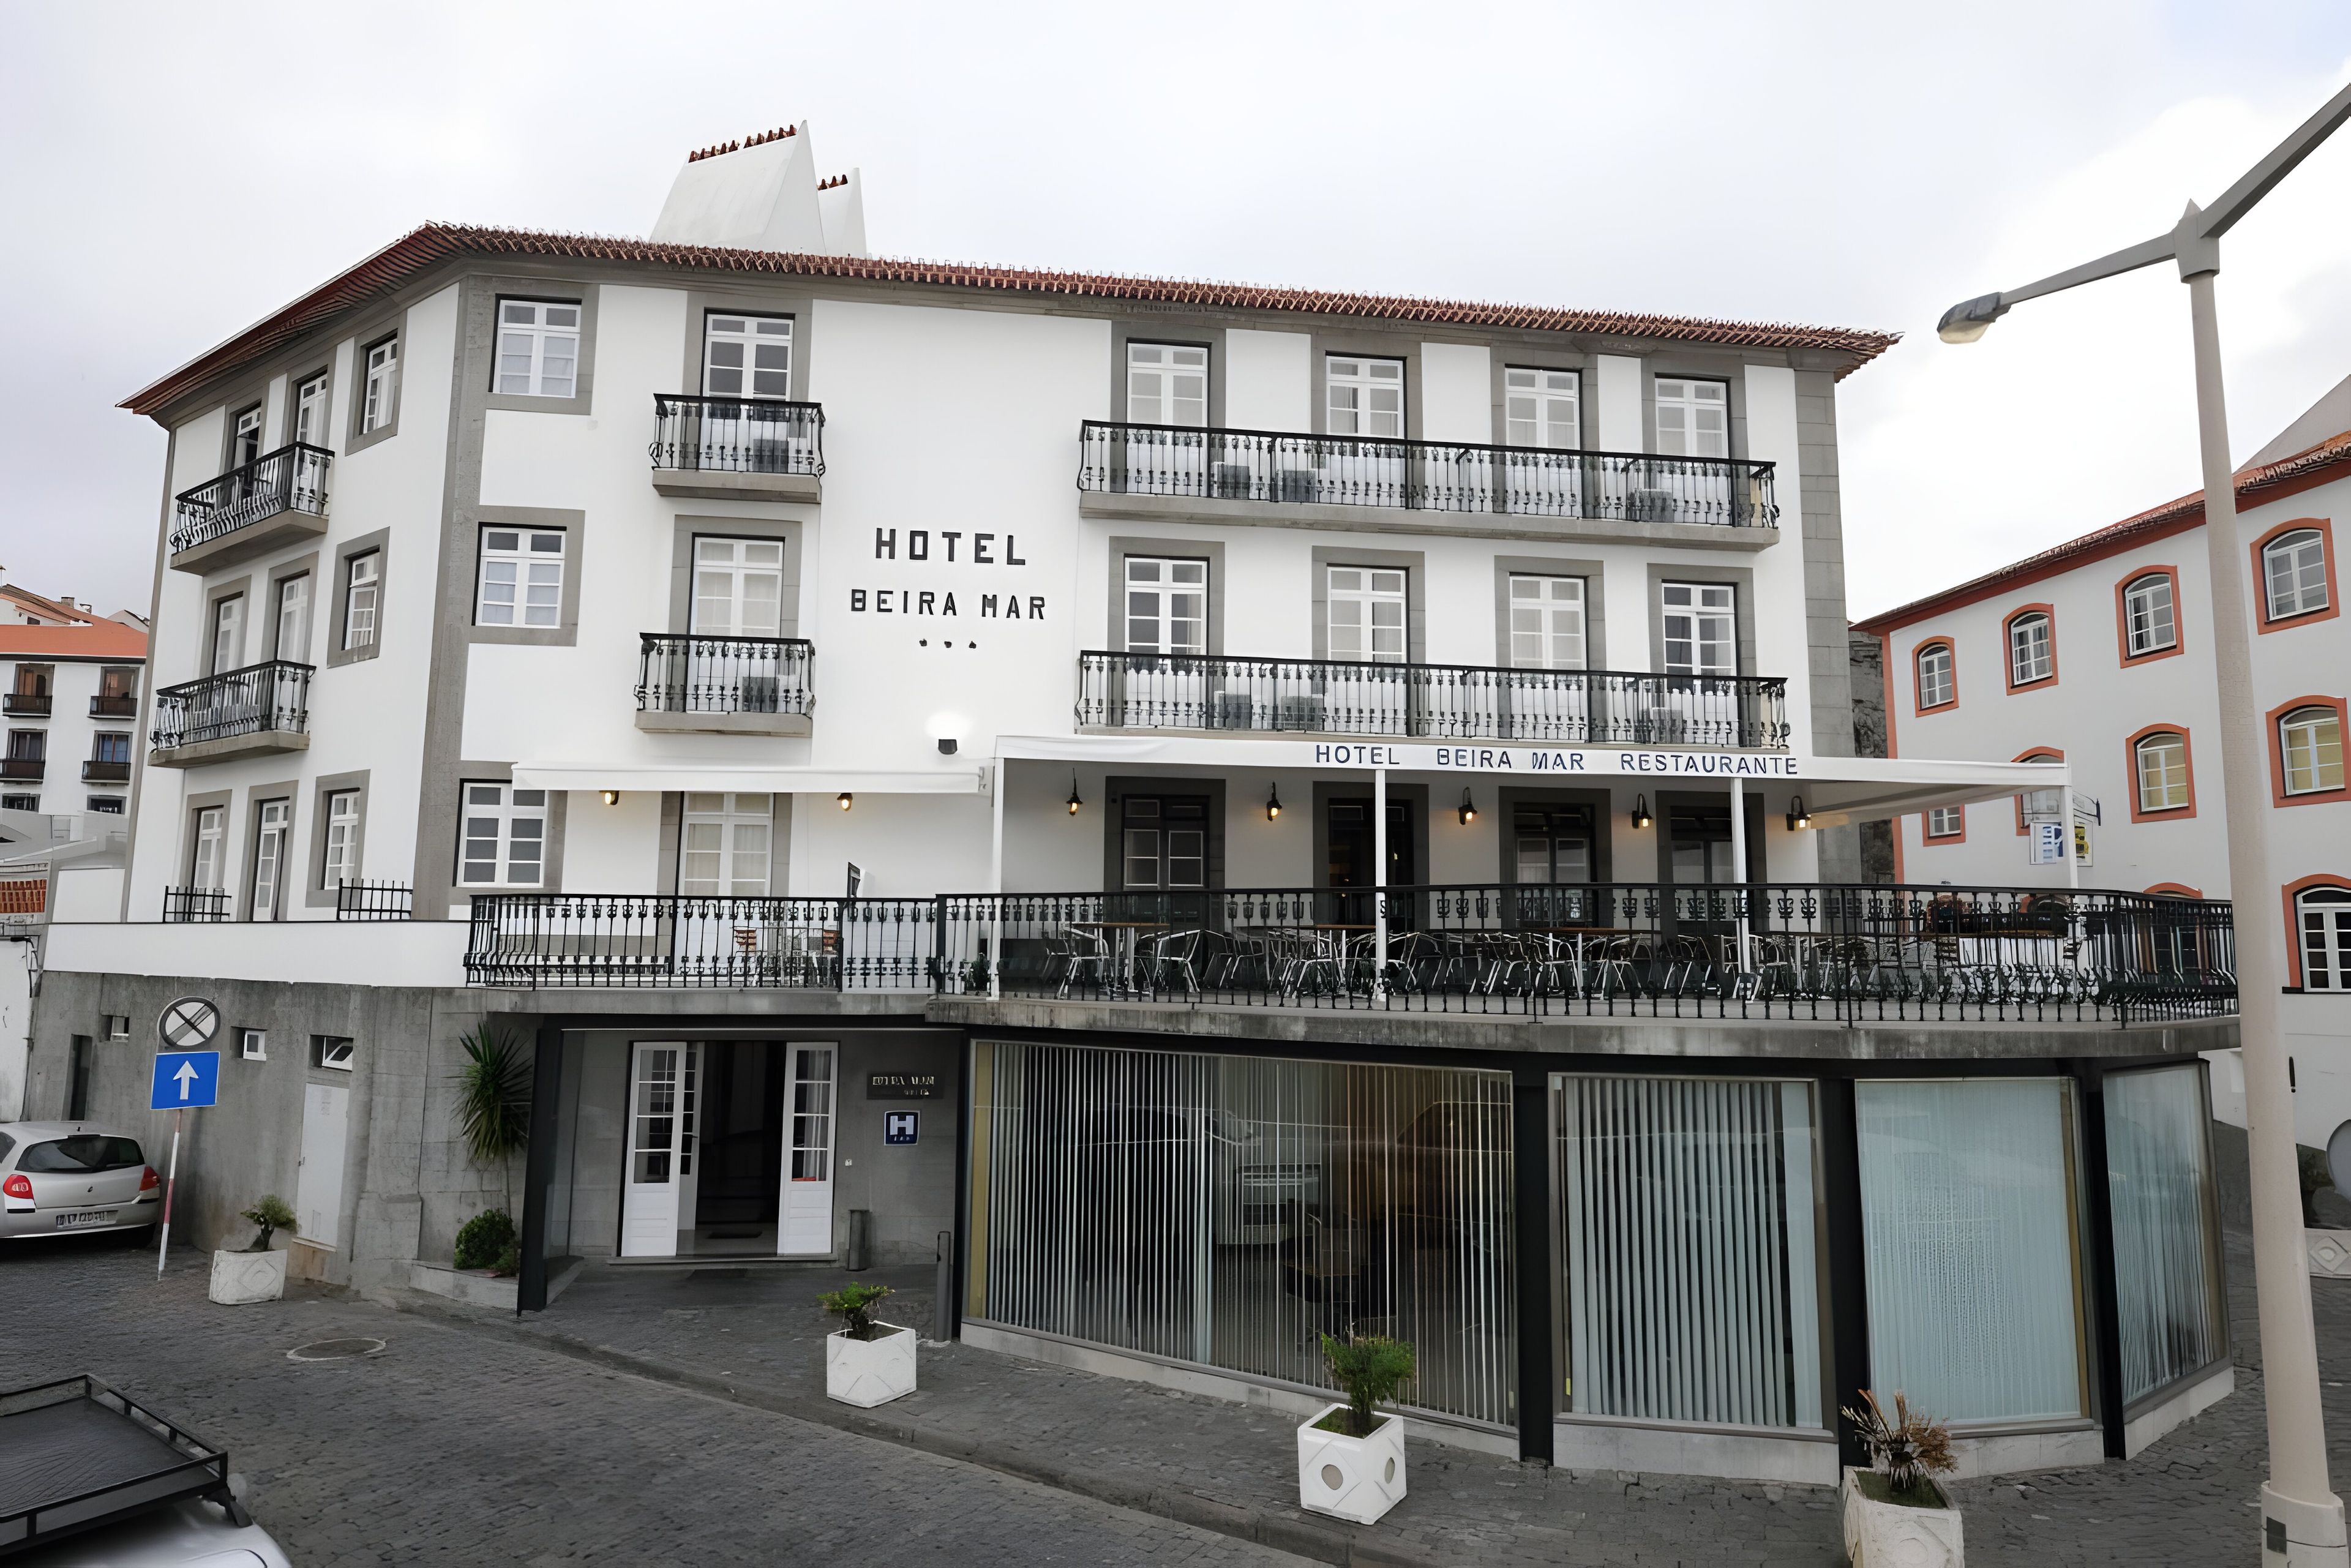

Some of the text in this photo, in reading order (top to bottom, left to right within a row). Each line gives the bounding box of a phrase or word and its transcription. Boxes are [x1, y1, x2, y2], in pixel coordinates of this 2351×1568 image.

[876, 528, 1026, 565] HOTEL
[851, 589, 1044, 620] BEIRA MAR
[1316, 745, 1798, 775] HOTEL BEIRA MAR RESTAURANTE
[890, 1116, 915, 1135] H
